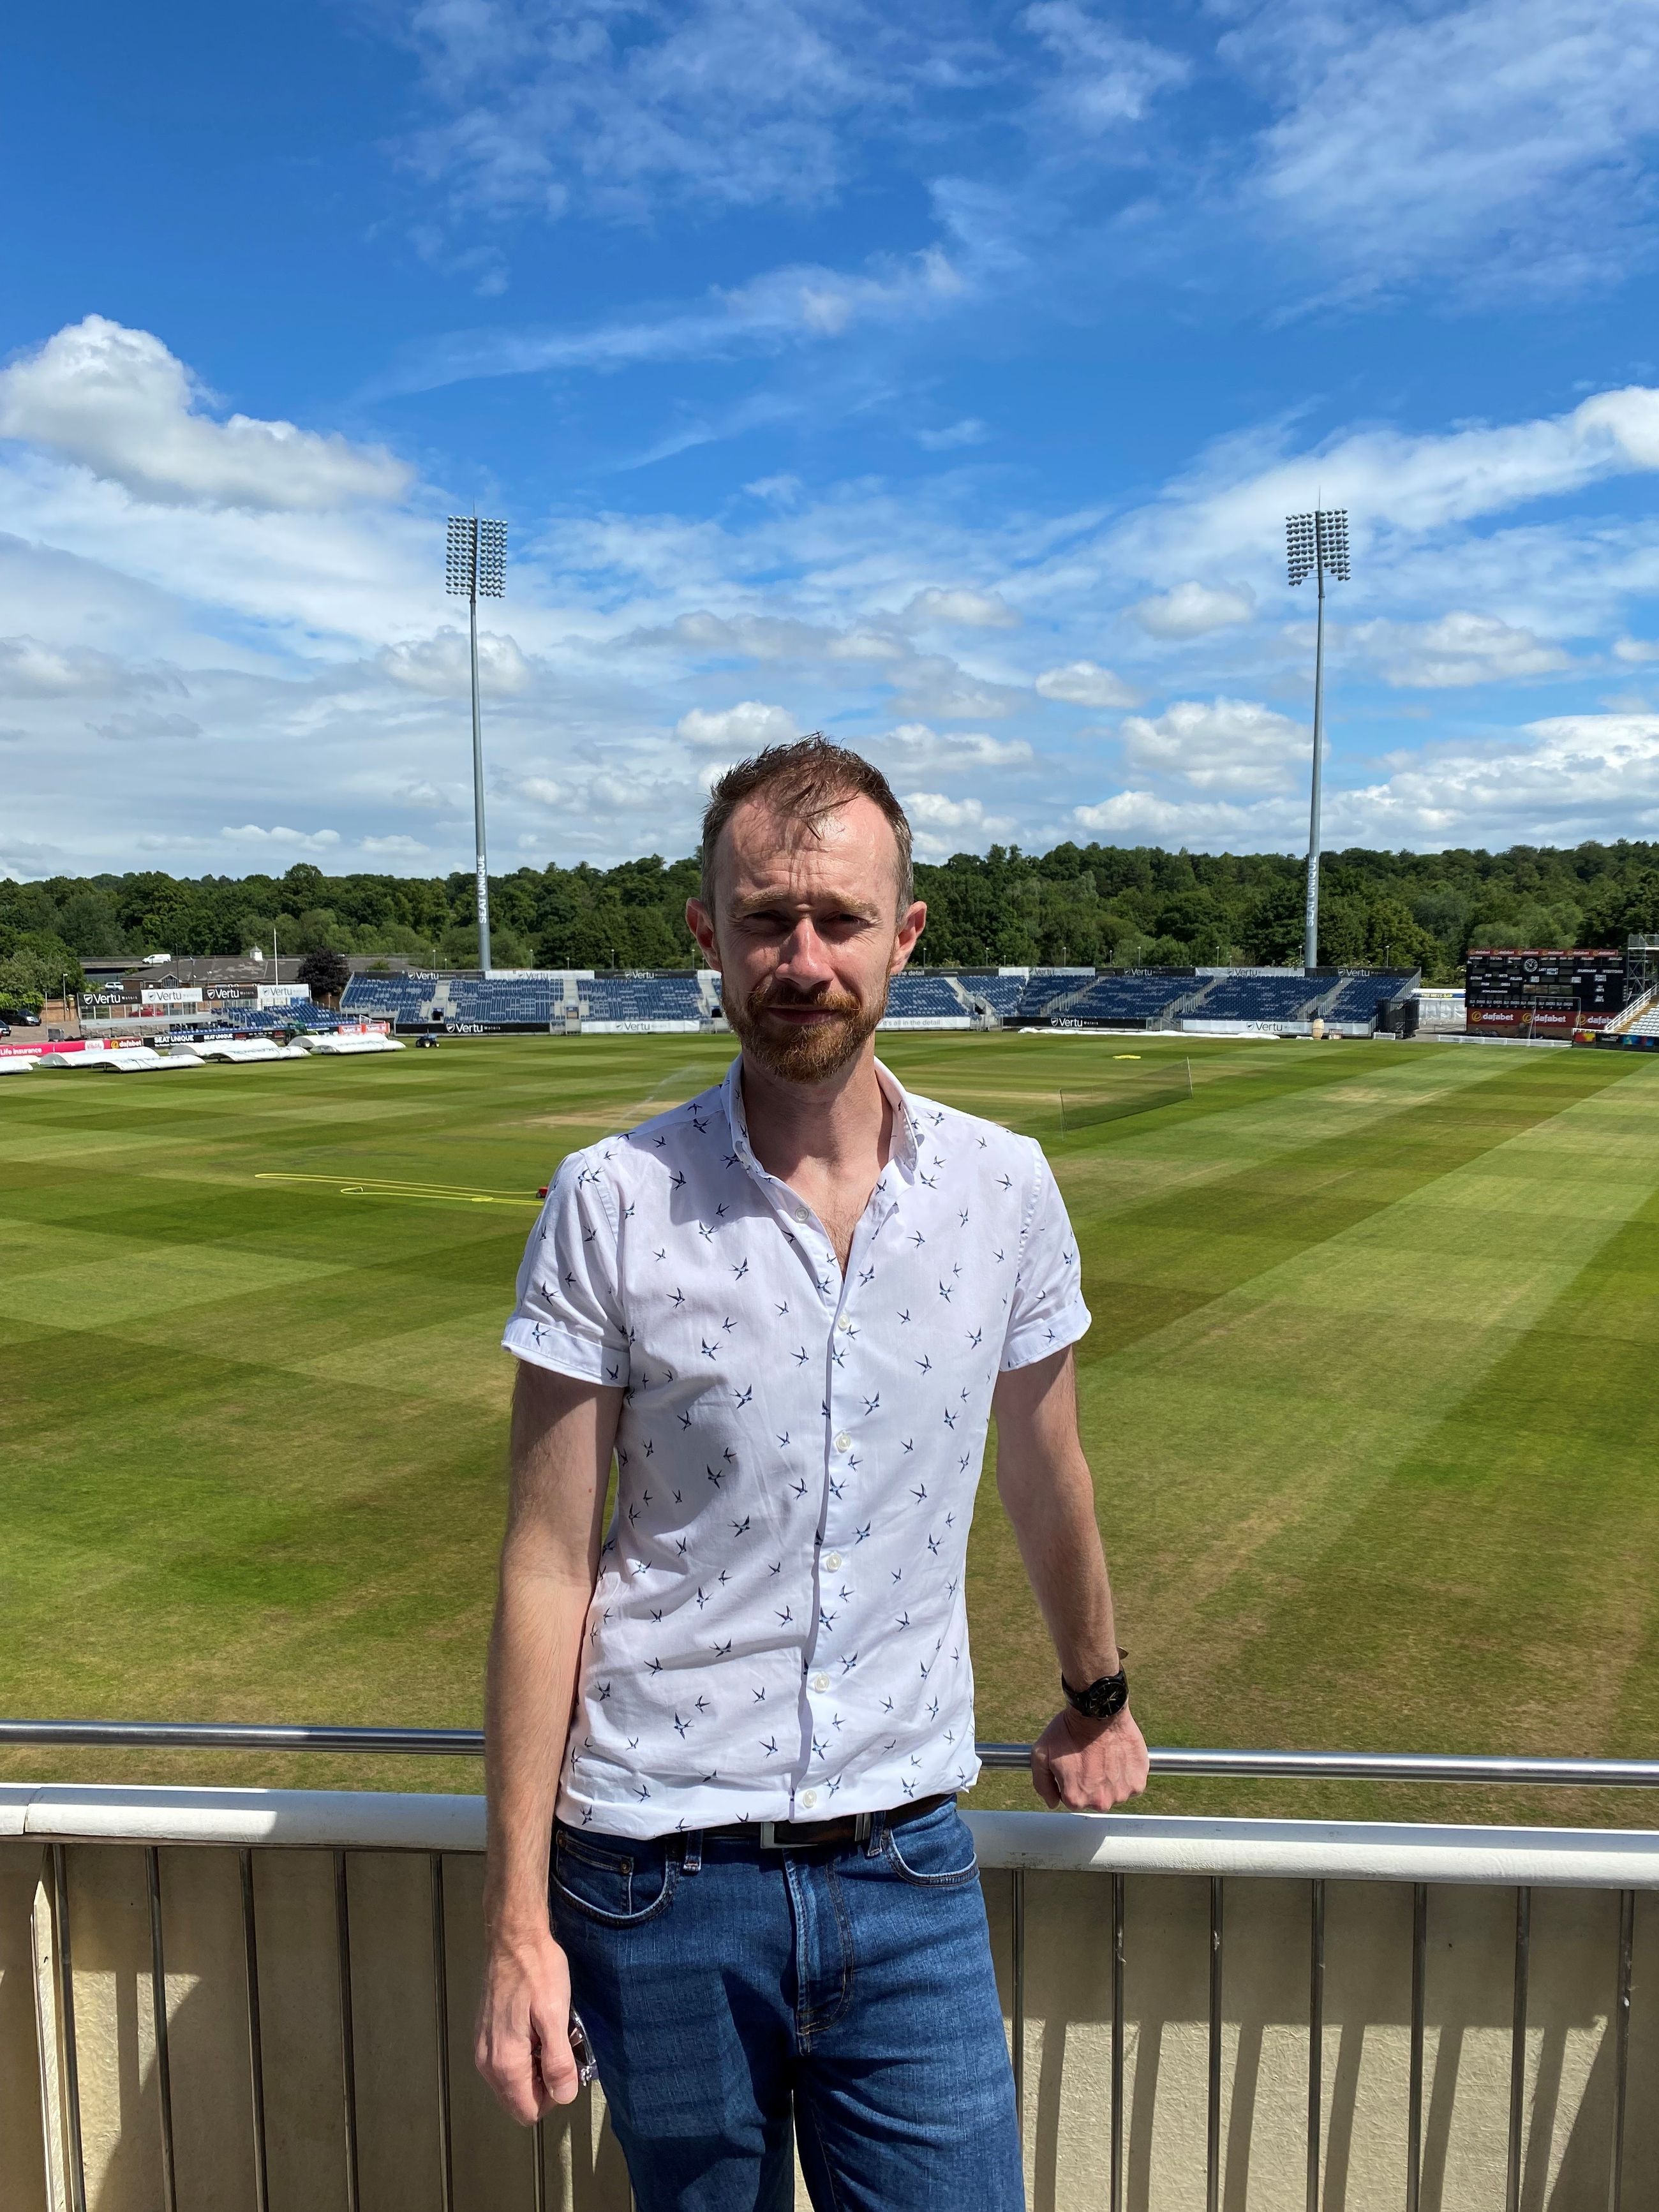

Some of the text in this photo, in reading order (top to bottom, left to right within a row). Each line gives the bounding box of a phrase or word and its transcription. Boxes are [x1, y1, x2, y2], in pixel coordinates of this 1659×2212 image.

[477, 855, 486, 894] UNIQUE
[1308, 856, 1317, 897] UNIQUE
[416, 972, 439, 980] Vertu
[1131, 968, 1152, 976] Vertu
[156, 991, 182, 1001] Vertu
[215, 988, 239, 998] Vertu
[270, 988, 292, 996] Vertu
[93, 993, 121, 1004] Vertu
[1483, 1013, 1514, 1021] dafabet
[1534, 1014, 1566, 1023] dafabet
[624, 1022, 650, 1031] Vertu
[1059, 1018, 1083, 1027] Vertu
[1255, 1022, 1283, 1031] Vertu
[456, 1023, 483, 1033] Vertu
[119, 1039, 142, 1048] dafabet
[154, 1034, 194, 1044] SEAT UNIQUE
